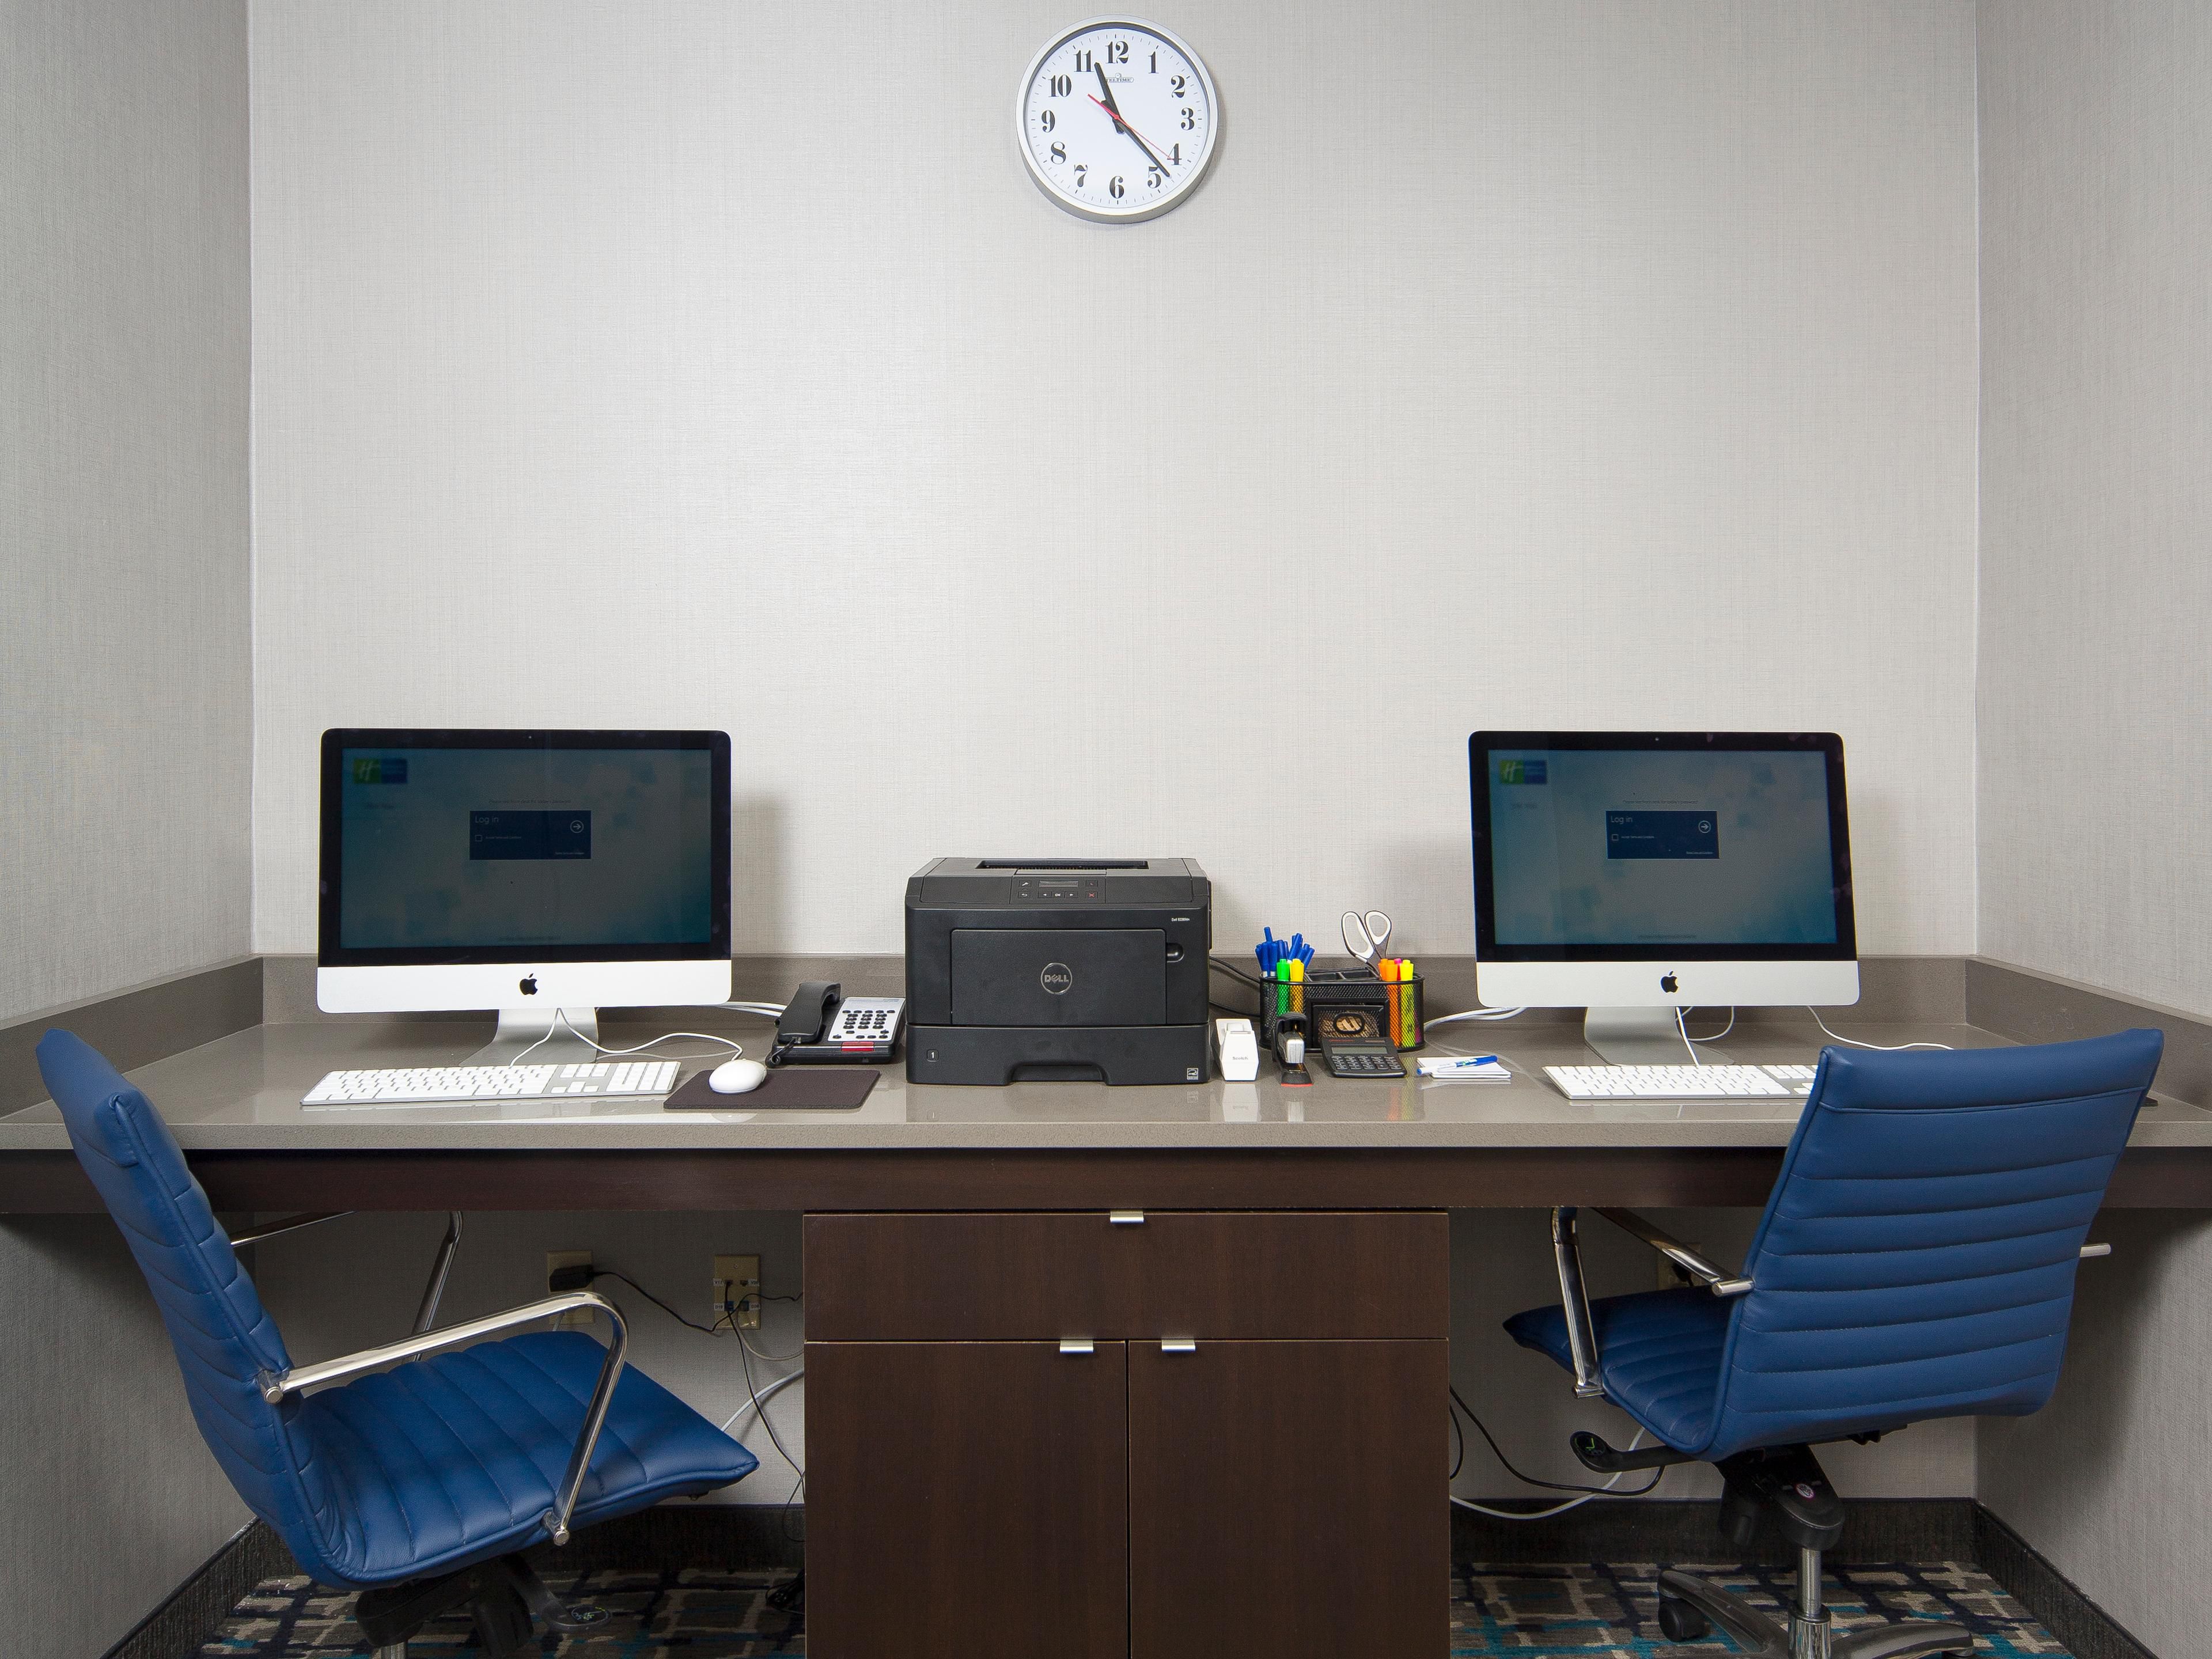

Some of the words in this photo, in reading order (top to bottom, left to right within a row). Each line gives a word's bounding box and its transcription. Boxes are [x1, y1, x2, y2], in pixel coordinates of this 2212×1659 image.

[1074, 50, 1094, 73] 11
[1105, 41, 1129, 64] 12
[1148, 51, 1159, 74] 1
[1048, 74, 1072, 97] 10
[1171, 75, 1185, 98] 2
[1041, 110, 1055, 132] 9
[1181, 107, 1195, 130] 3
[1050, 141, 1066, 165] 8
[1166, 143, 1182, 165] 4
[1074, 164, 1088, 187] 7
[1147, 166, 1161, 189] 5
[1109, 176, 1124, 199] 6
[475, 816, 489, 824] Log
[1611, 816, 1624, 824] Log
[1044, 974, 1069, 983] DELL
